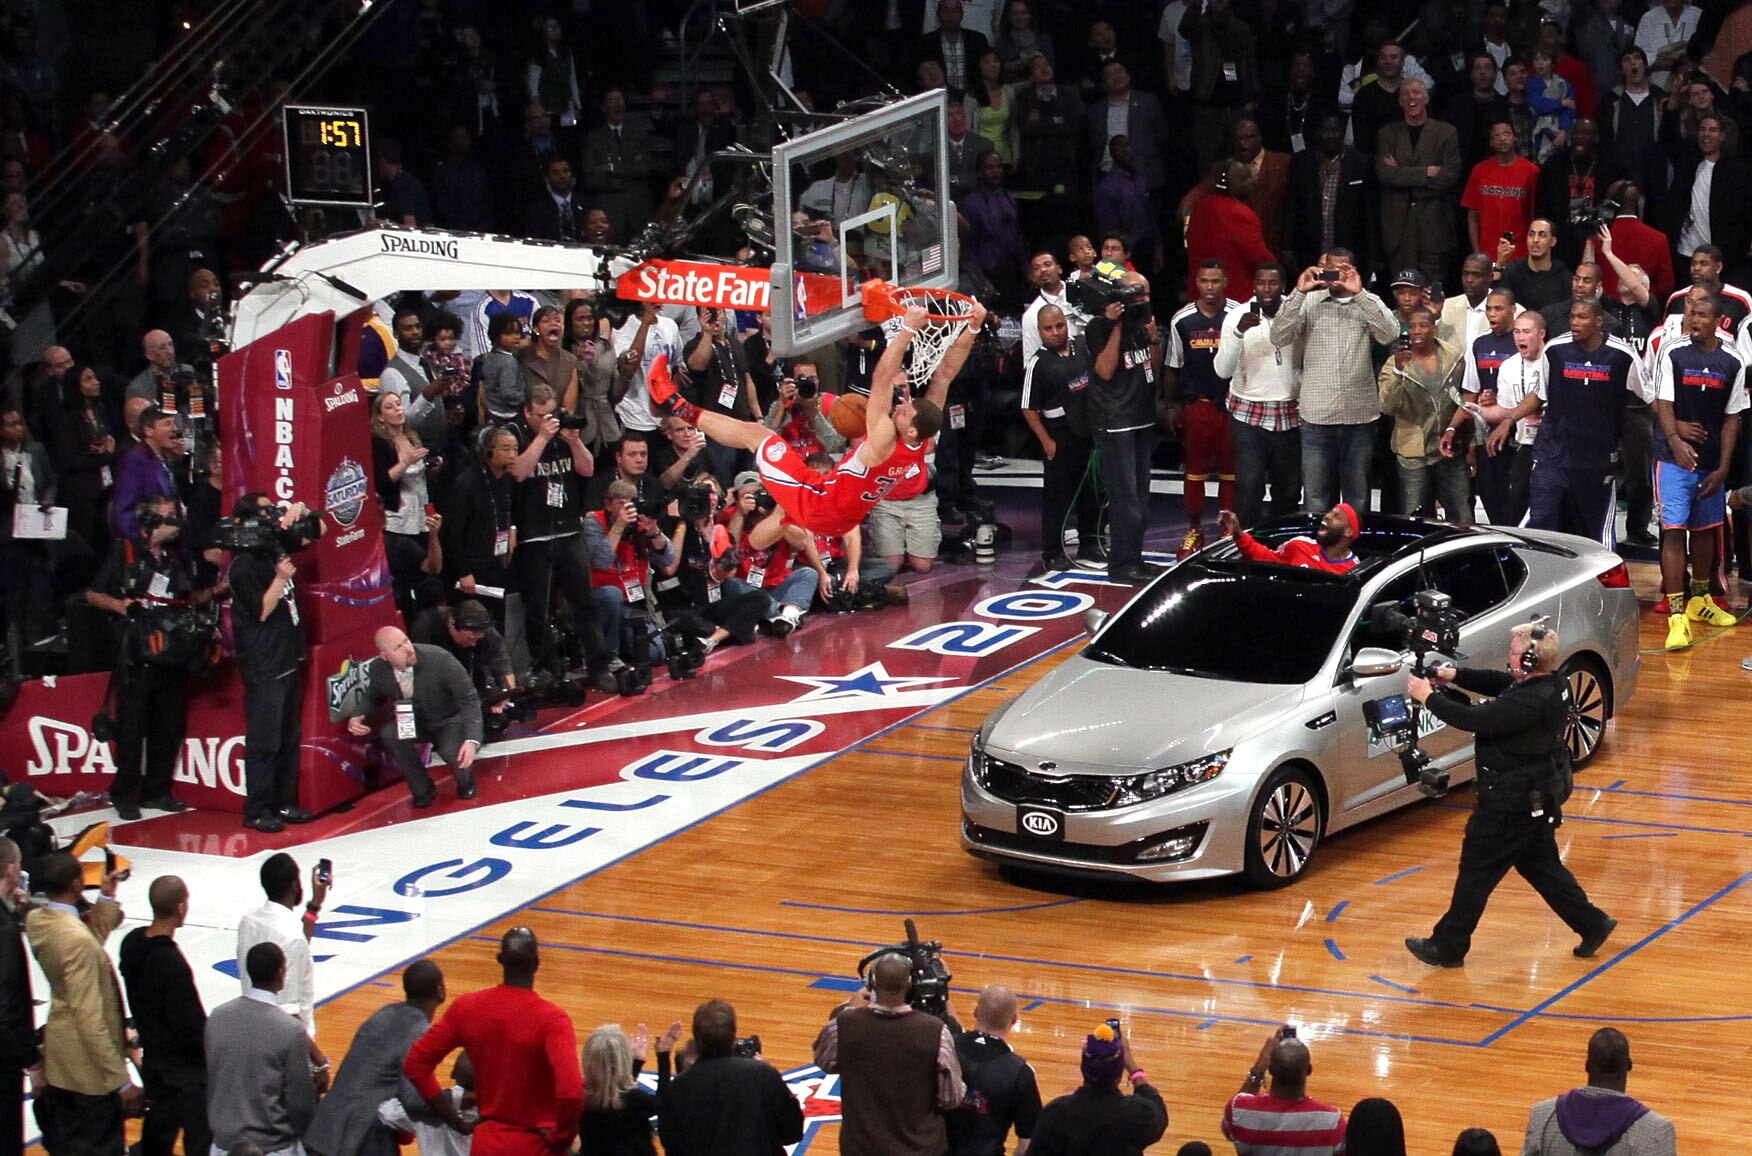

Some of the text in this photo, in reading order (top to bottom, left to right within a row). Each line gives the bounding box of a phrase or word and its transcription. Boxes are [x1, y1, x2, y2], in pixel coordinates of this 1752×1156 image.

[320, 120, 362, 147] 1:57
[380, 233, 459, 260] SPALDING
[324, 388, 360, 412] SPALDING
[332, 667, 358, 706] Sprite
[27, 715, 248, 797] SPANG
[1028, 815, 1053, 832] KIA
[212, 717, 816, 982] NGELES
